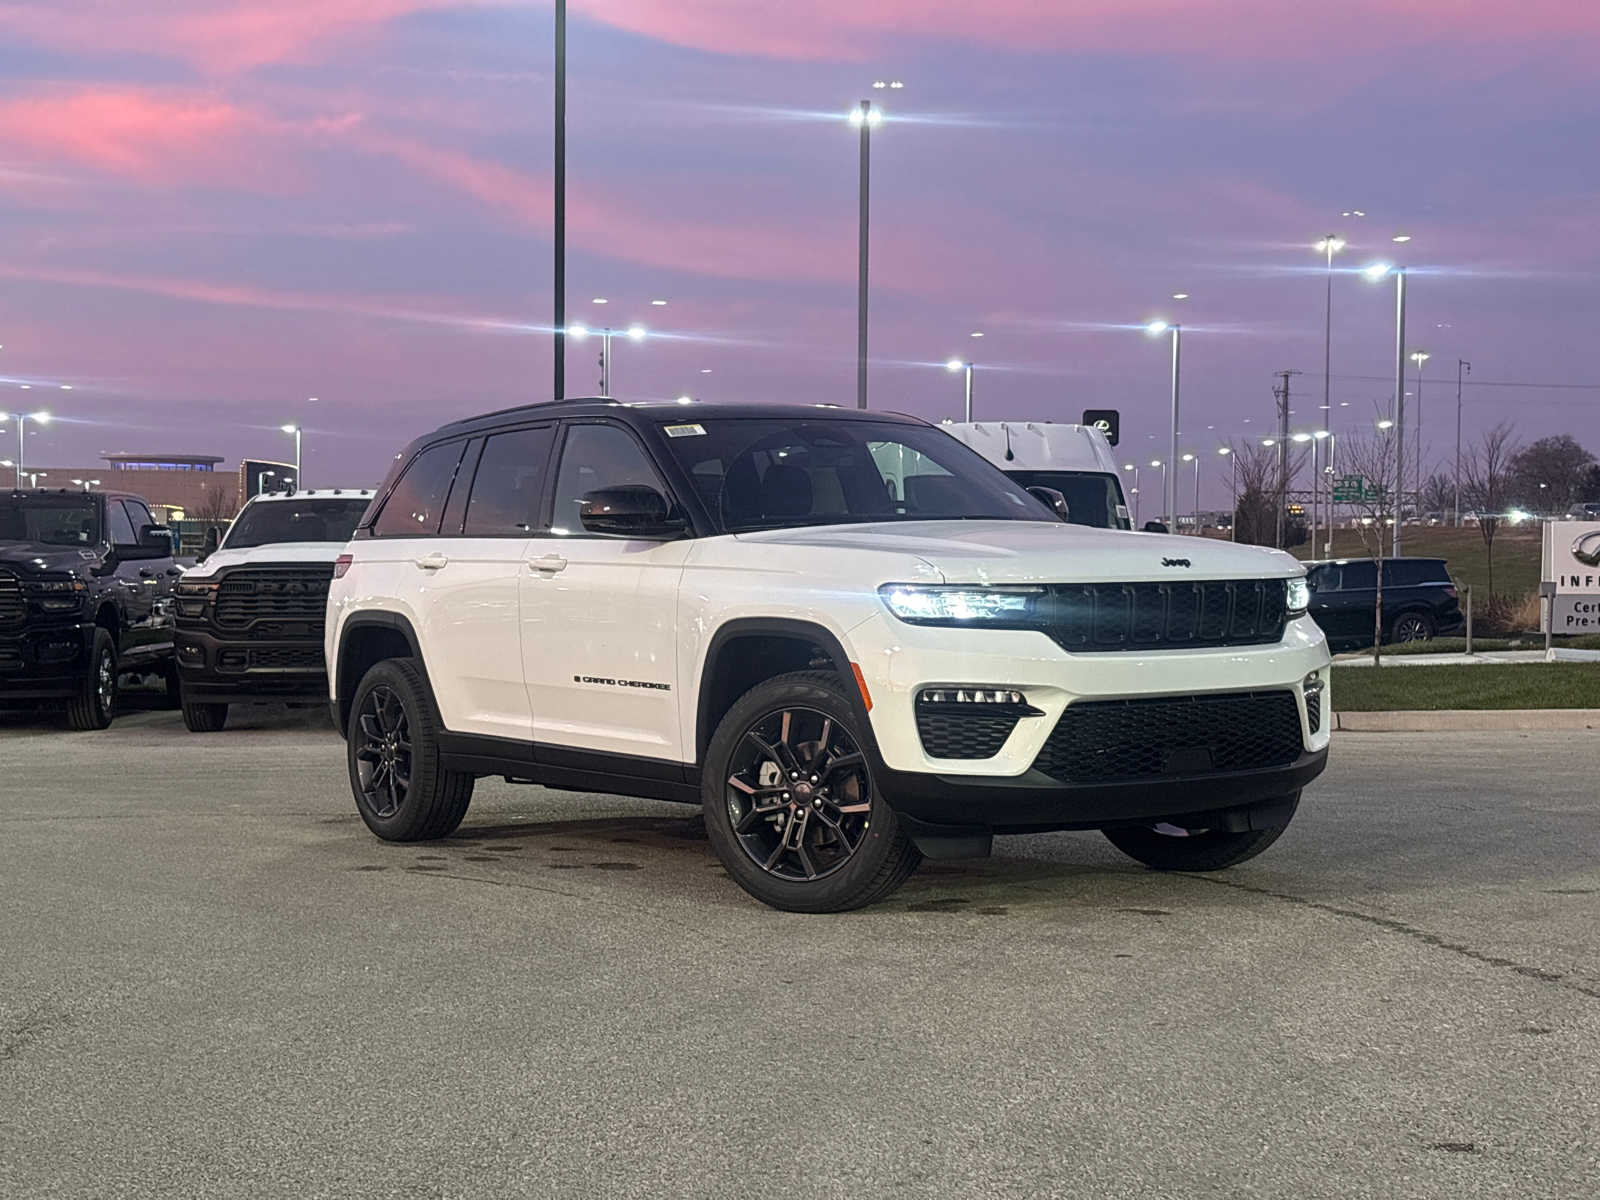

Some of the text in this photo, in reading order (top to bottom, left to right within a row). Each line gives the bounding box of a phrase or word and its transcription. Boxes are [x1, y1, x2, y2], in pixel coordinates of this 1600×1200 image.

[1161, 557, 1191, 568] Jeep
[1566, 615, 1600, 627] Pre-
[582, 676, 671, 691] GRAND CHEROKEE
